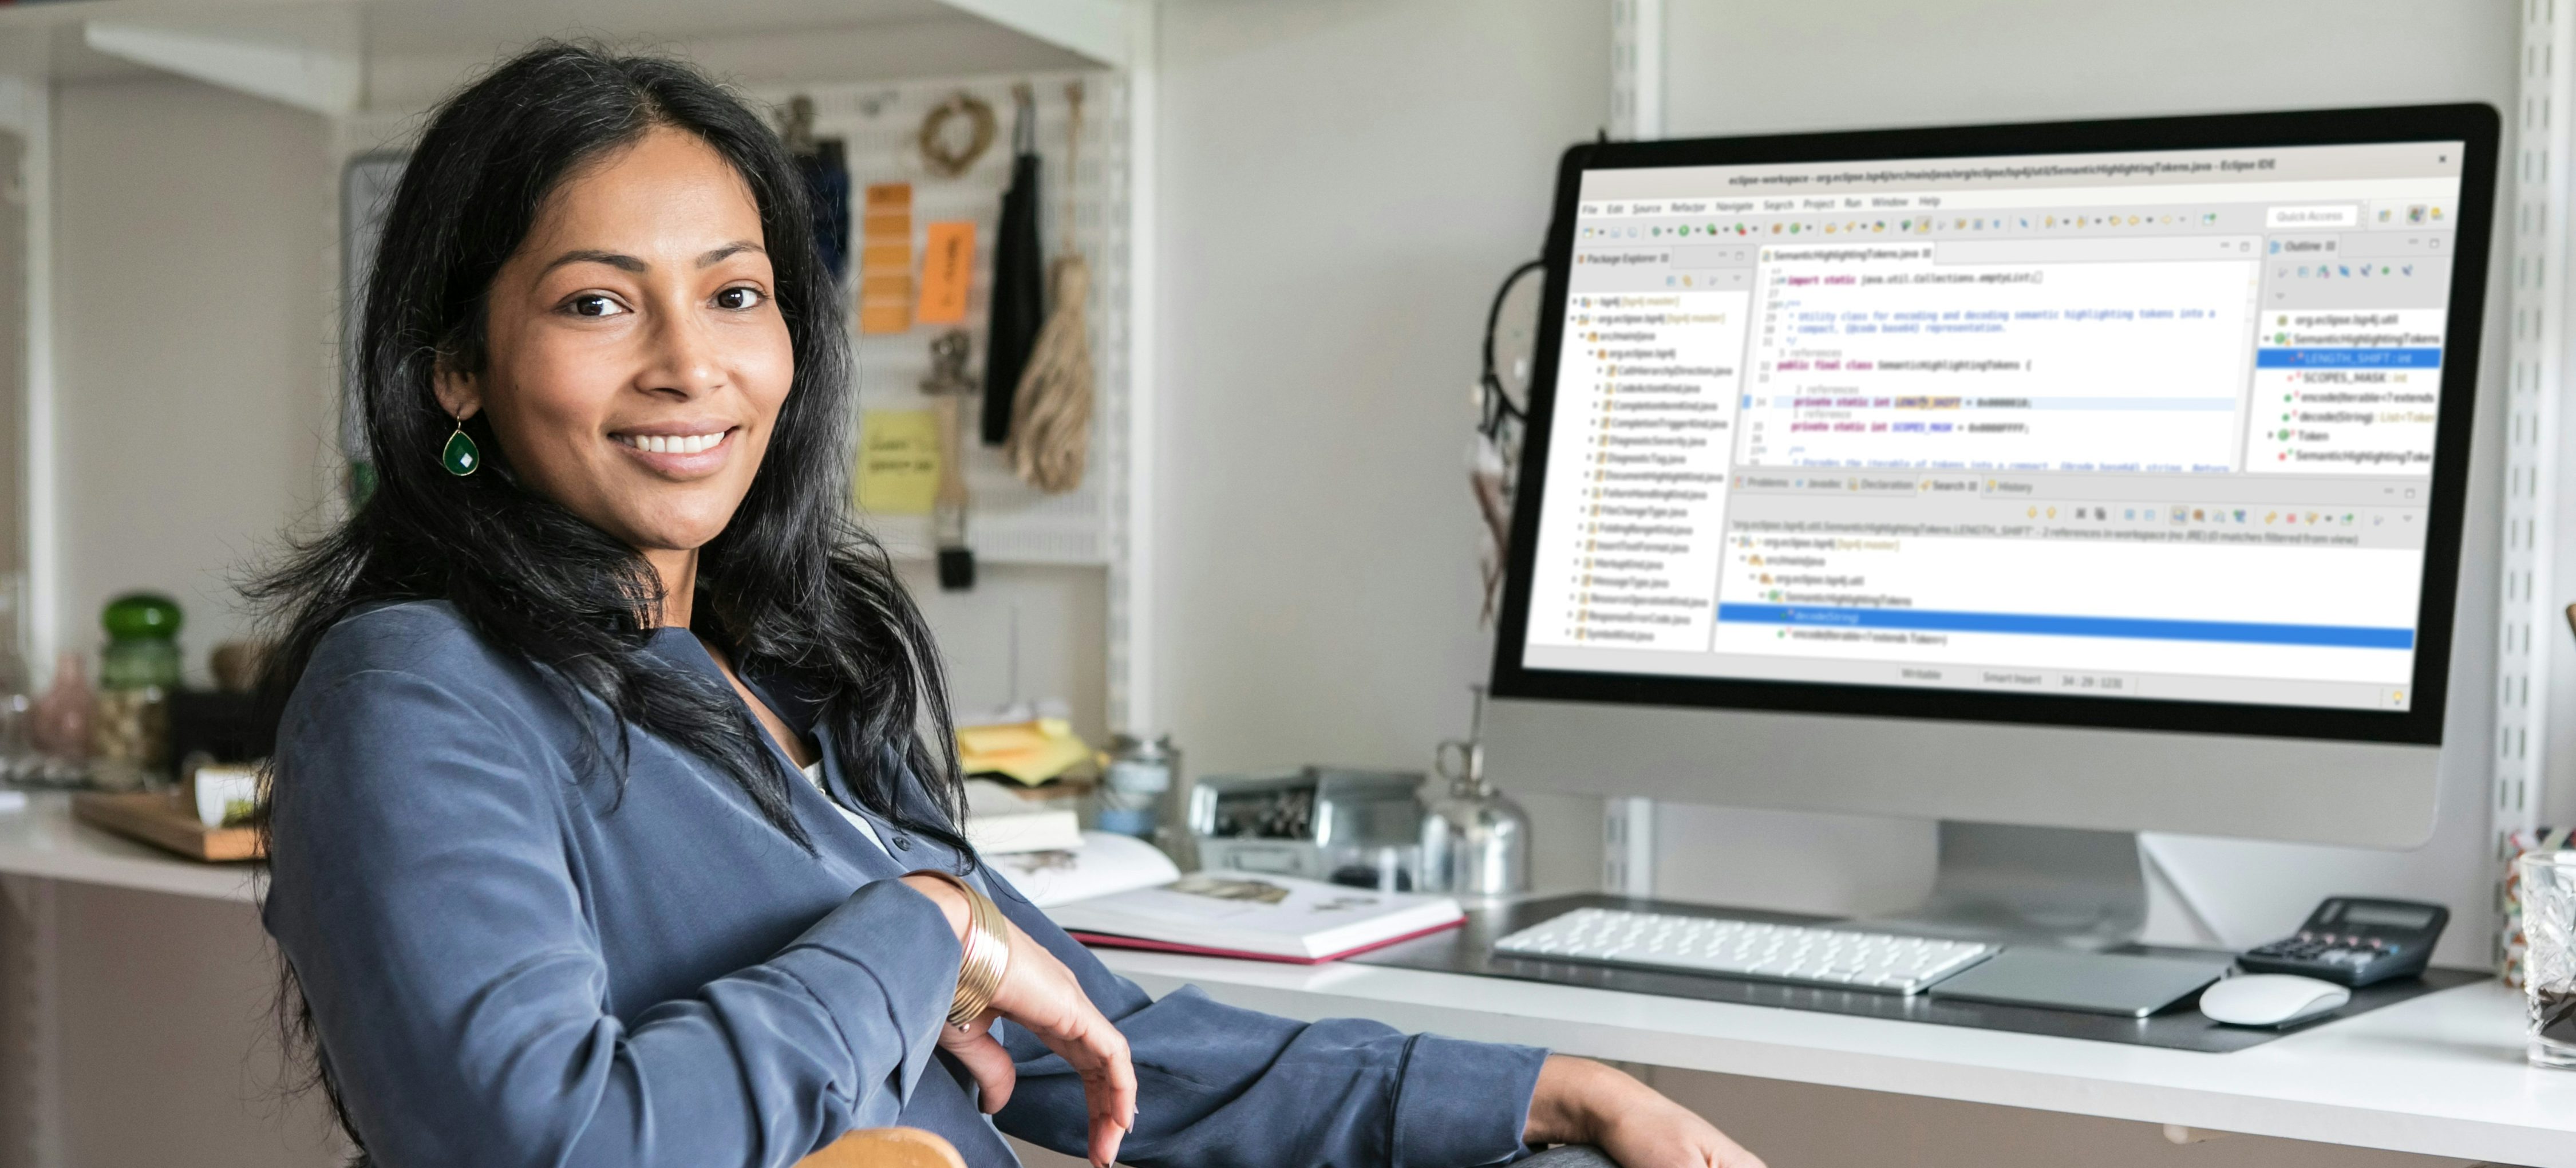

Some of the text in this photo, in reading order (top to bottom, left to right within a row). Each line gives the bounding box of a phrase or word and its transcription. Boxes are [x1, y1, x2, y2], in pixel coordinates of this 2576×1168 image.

[2221, 160, 2255, 172] Eclipse
[2258, 159, 2275, 169] IDE
[1671, 202, 1706, 213] Refactor
[1716, 200, 1753, 213] Navigate
[1763, 199, 1794, 211] Search
[1803, 198, 1835, 211] Project
[1844, 198, 1862, 208] Run
[1871, 196, 1909, 208] Window
[1919, 196, 1941, 208] Help
[1582, 204, 1598, 215] File
[1607, 203, 1623, 214] Edit
[1632, 203, 1662, 214] Source
[2277, 211, 2343, 222] Quick Access
[2285, 242, 2321, 251] Outline
[1587, 253, 1657, 265] Package Explorer
[1774, 250, 1919, 263] SemanticHighlightingTokens.java
[1788, 276, 1819, 286] import
[1824, 275, 1856, 285] static
[1798, 311, 1836, 322] Utility
[1841, 311, 1867, 321] class
[1873, 311, 1888, 319] for
[1894, 311, 1937, 322] encoding
[1943, 311, 1959, 319] and
[1965, 310, 2009, 321] decoding
[2014, 310, 2059, 319] semantic
[2065, 309, 2134, 321] highlighting
[2140, 309, 2174, 318] tokens
[2180, 309, 2203, 318] into
[2295, 315, 2398, 328] org.eclipse.lsp4j.util
[2294, 333, 2439, 346] SemanticHighlightingTokens
[1790, 348, 1842, 358] references
[2305, 352, 2412, 365] LENGTH_SHIFT int
[1777, 361, 1809, 372] public
[1815, 361, 1840, 370] final
[1846, 361, 1872, 370] class
[1878, 360, 2020, 372] SemanticHighlightingTokens
[2304, 373, 2407, 384] SCOPES_MASK int
[1807, 385, 1859, 395] references
[1793, 397, 1831, 408] private
[1836, 397, 1868, 407] static
[1874, 397, 1890, 407] int
[1804, 410, 1851, 420] reference
[1791, 421, 1829, 433] private
[1834, 422, 1866, 432] static
[1871, 422, 1887, 432] int
[2298, 431, 2329, 441] Token
[1747, 478, 1788, 488] Problems
[1808, 478, 1842, 489] Javadoc
[1861, 479, 1913, 490] Declaration
[1933, 481, 1965, 491] Search
[1998, 482, 2032, 494] History
[2050, 528, 2102, 538] references
[2104, 528, 2113, 538] in
[2115, 530, 2166, 540] workspace
[2221, 532, 2262, 542] matches
[2265, 532, 2302, 543] filtered
[2304, 534, 2328, 544] from
[2330, 534, 2358, 546] view)
[1786, 592, 1912, 606] SemanticHighlightingTokens
[1902, 669, 1941, 680] Writable
[1983, 672, 2041, 685] Smart Insert
